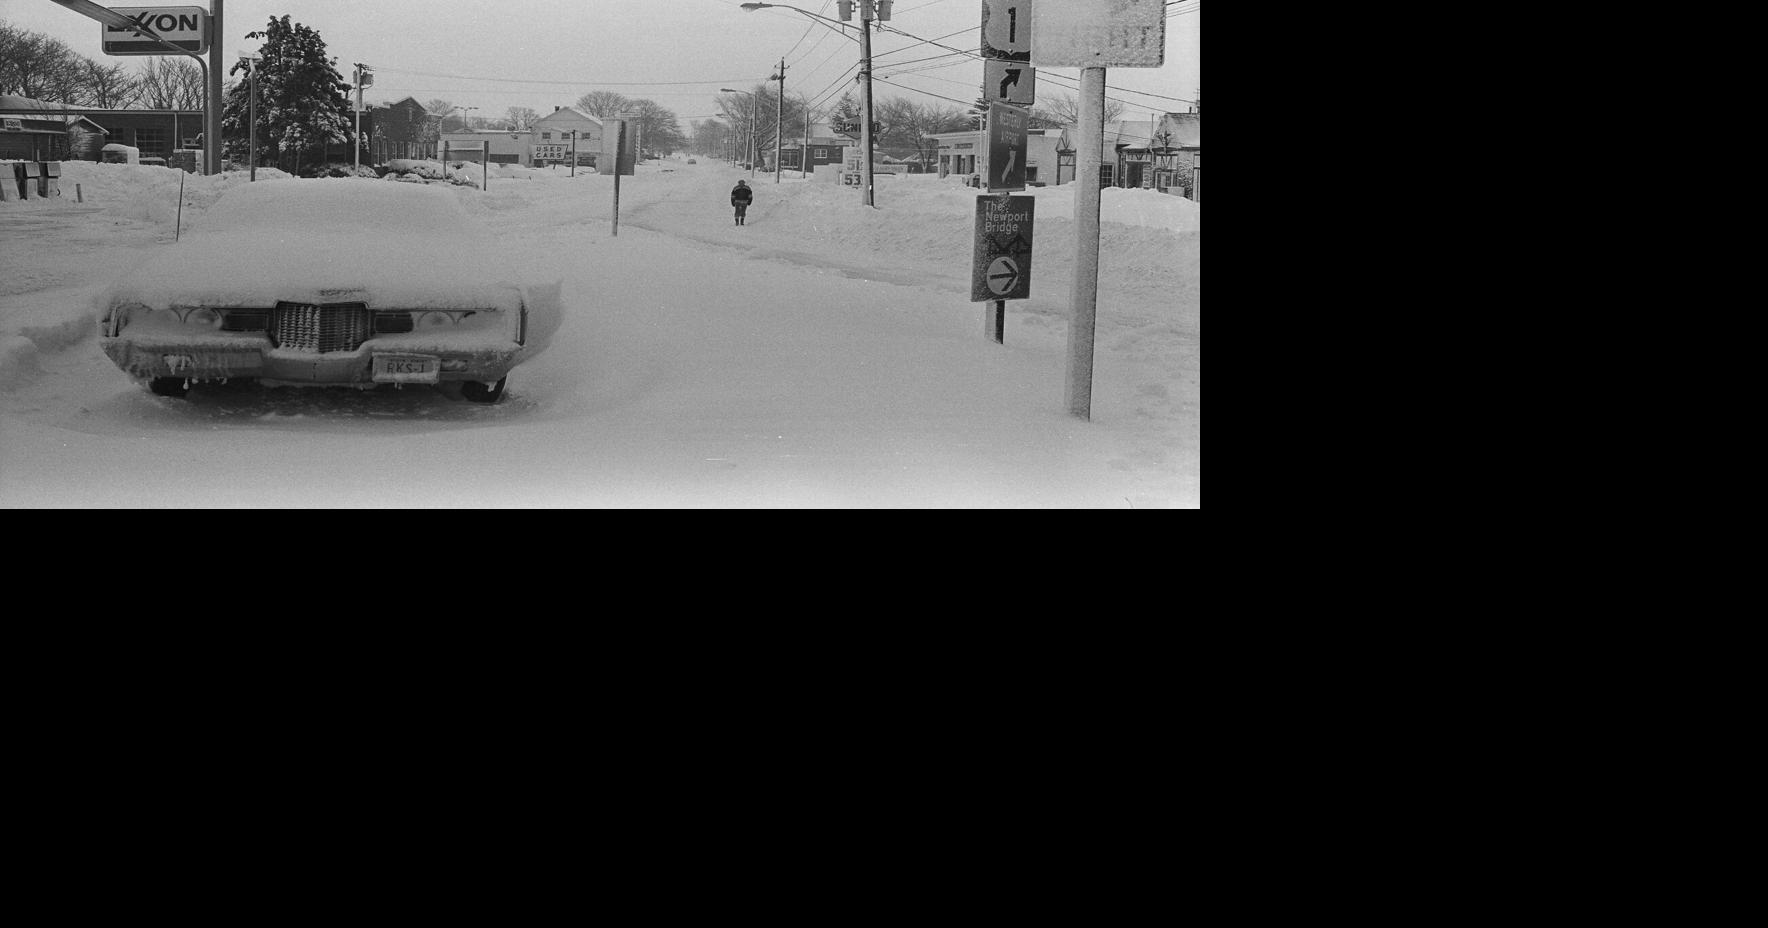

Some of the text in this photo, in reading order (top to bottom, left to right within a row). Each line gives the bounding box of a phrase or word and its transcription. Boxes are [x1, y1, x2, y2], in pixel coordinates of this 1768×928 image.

[1008, 6, 1016, 43] 1
[984, 200, 1003, 211] The
[985, 211, 1029, 224] Newport
[985, 221, 1018, 235] Bridge
